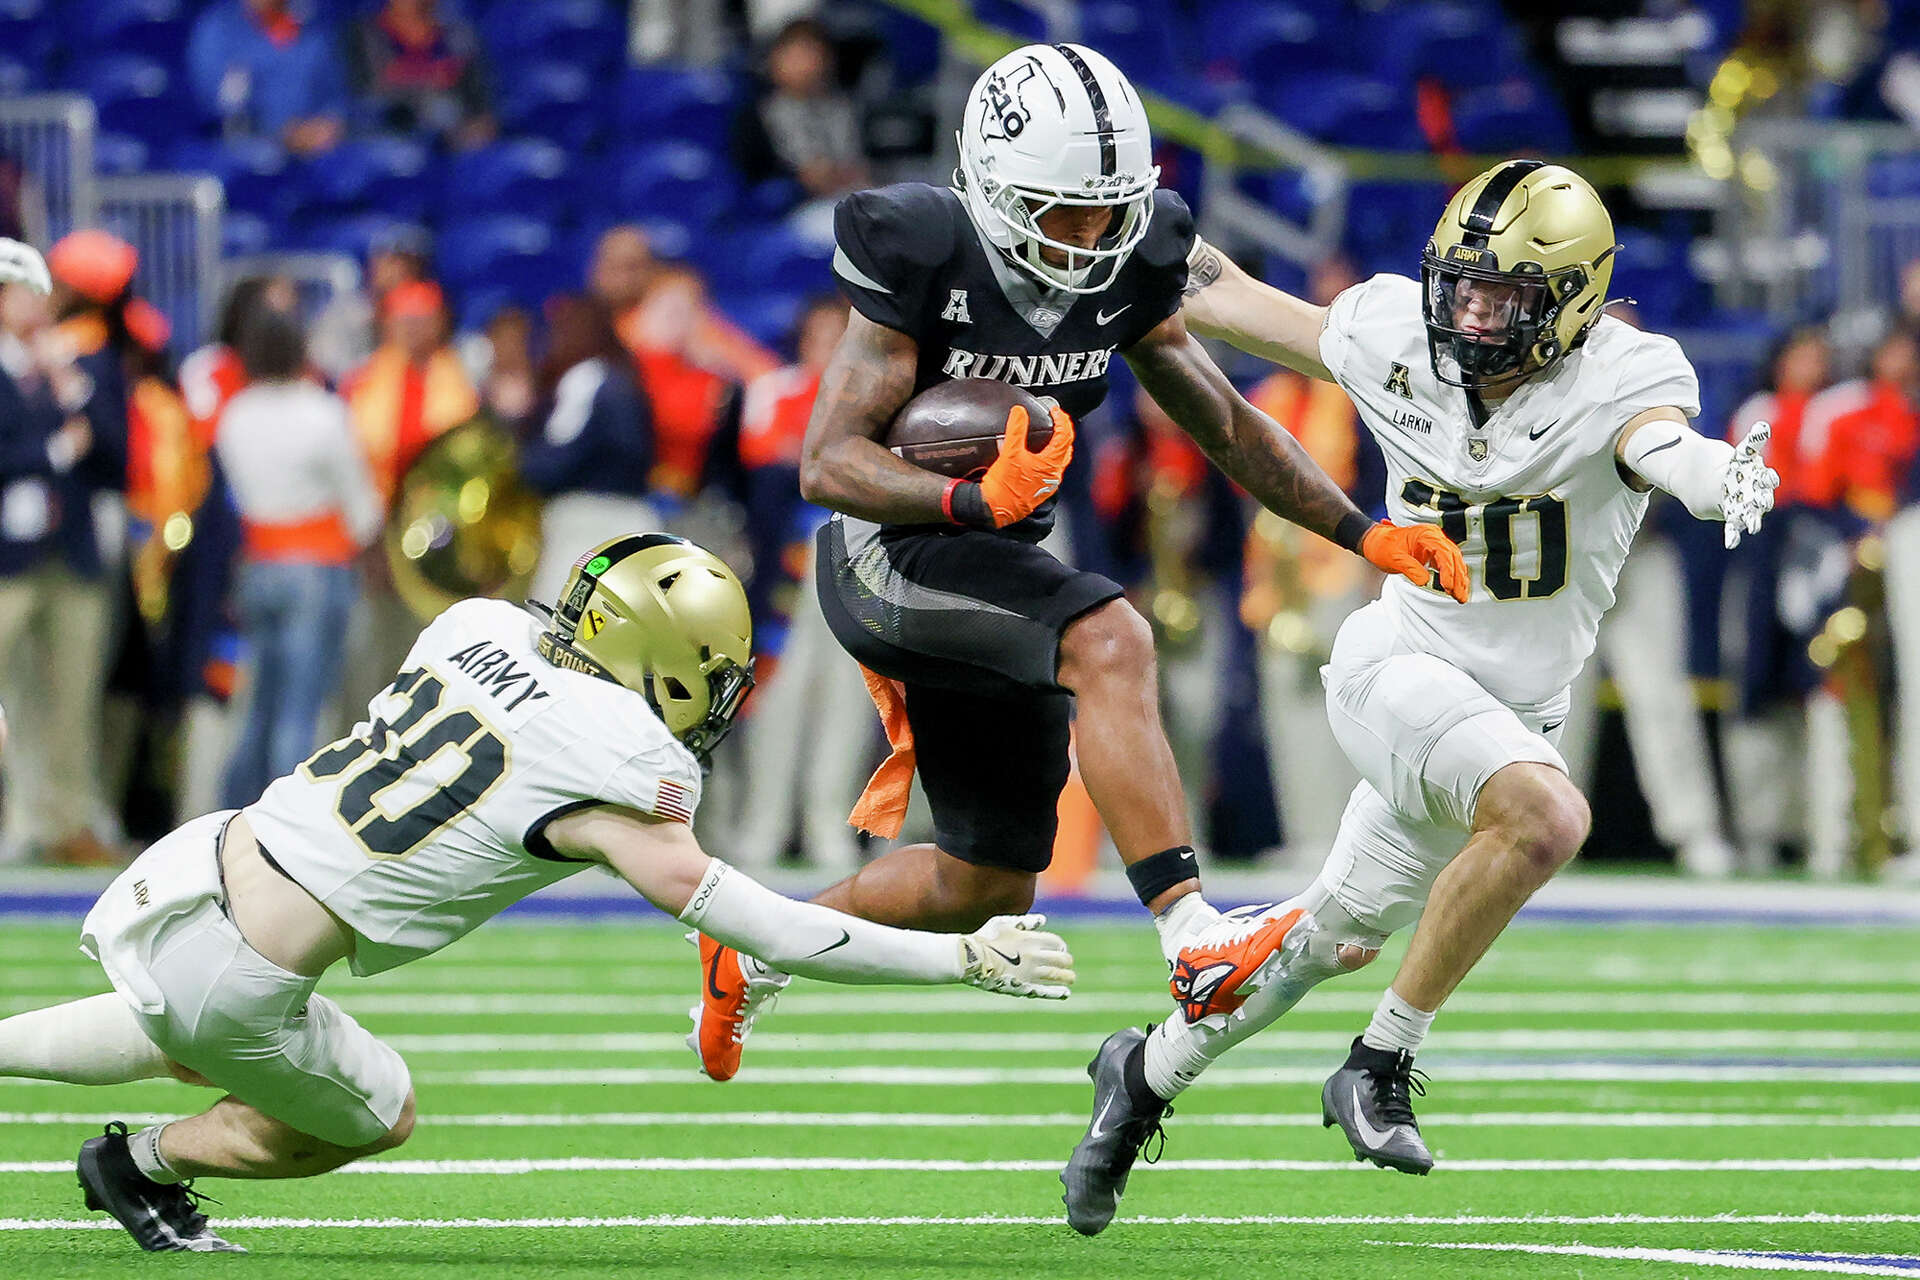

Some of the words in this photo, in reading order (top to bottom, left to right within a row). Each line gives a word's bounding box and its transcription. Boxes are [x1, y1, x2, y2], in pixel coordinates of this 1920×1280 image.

[1454, 247, 1483, 263] ARMY
[1392, 409, 1433, 435] LARKIN
[447, 641, 550, 713] ARMY
[694, 873, 720, 911] PRO
